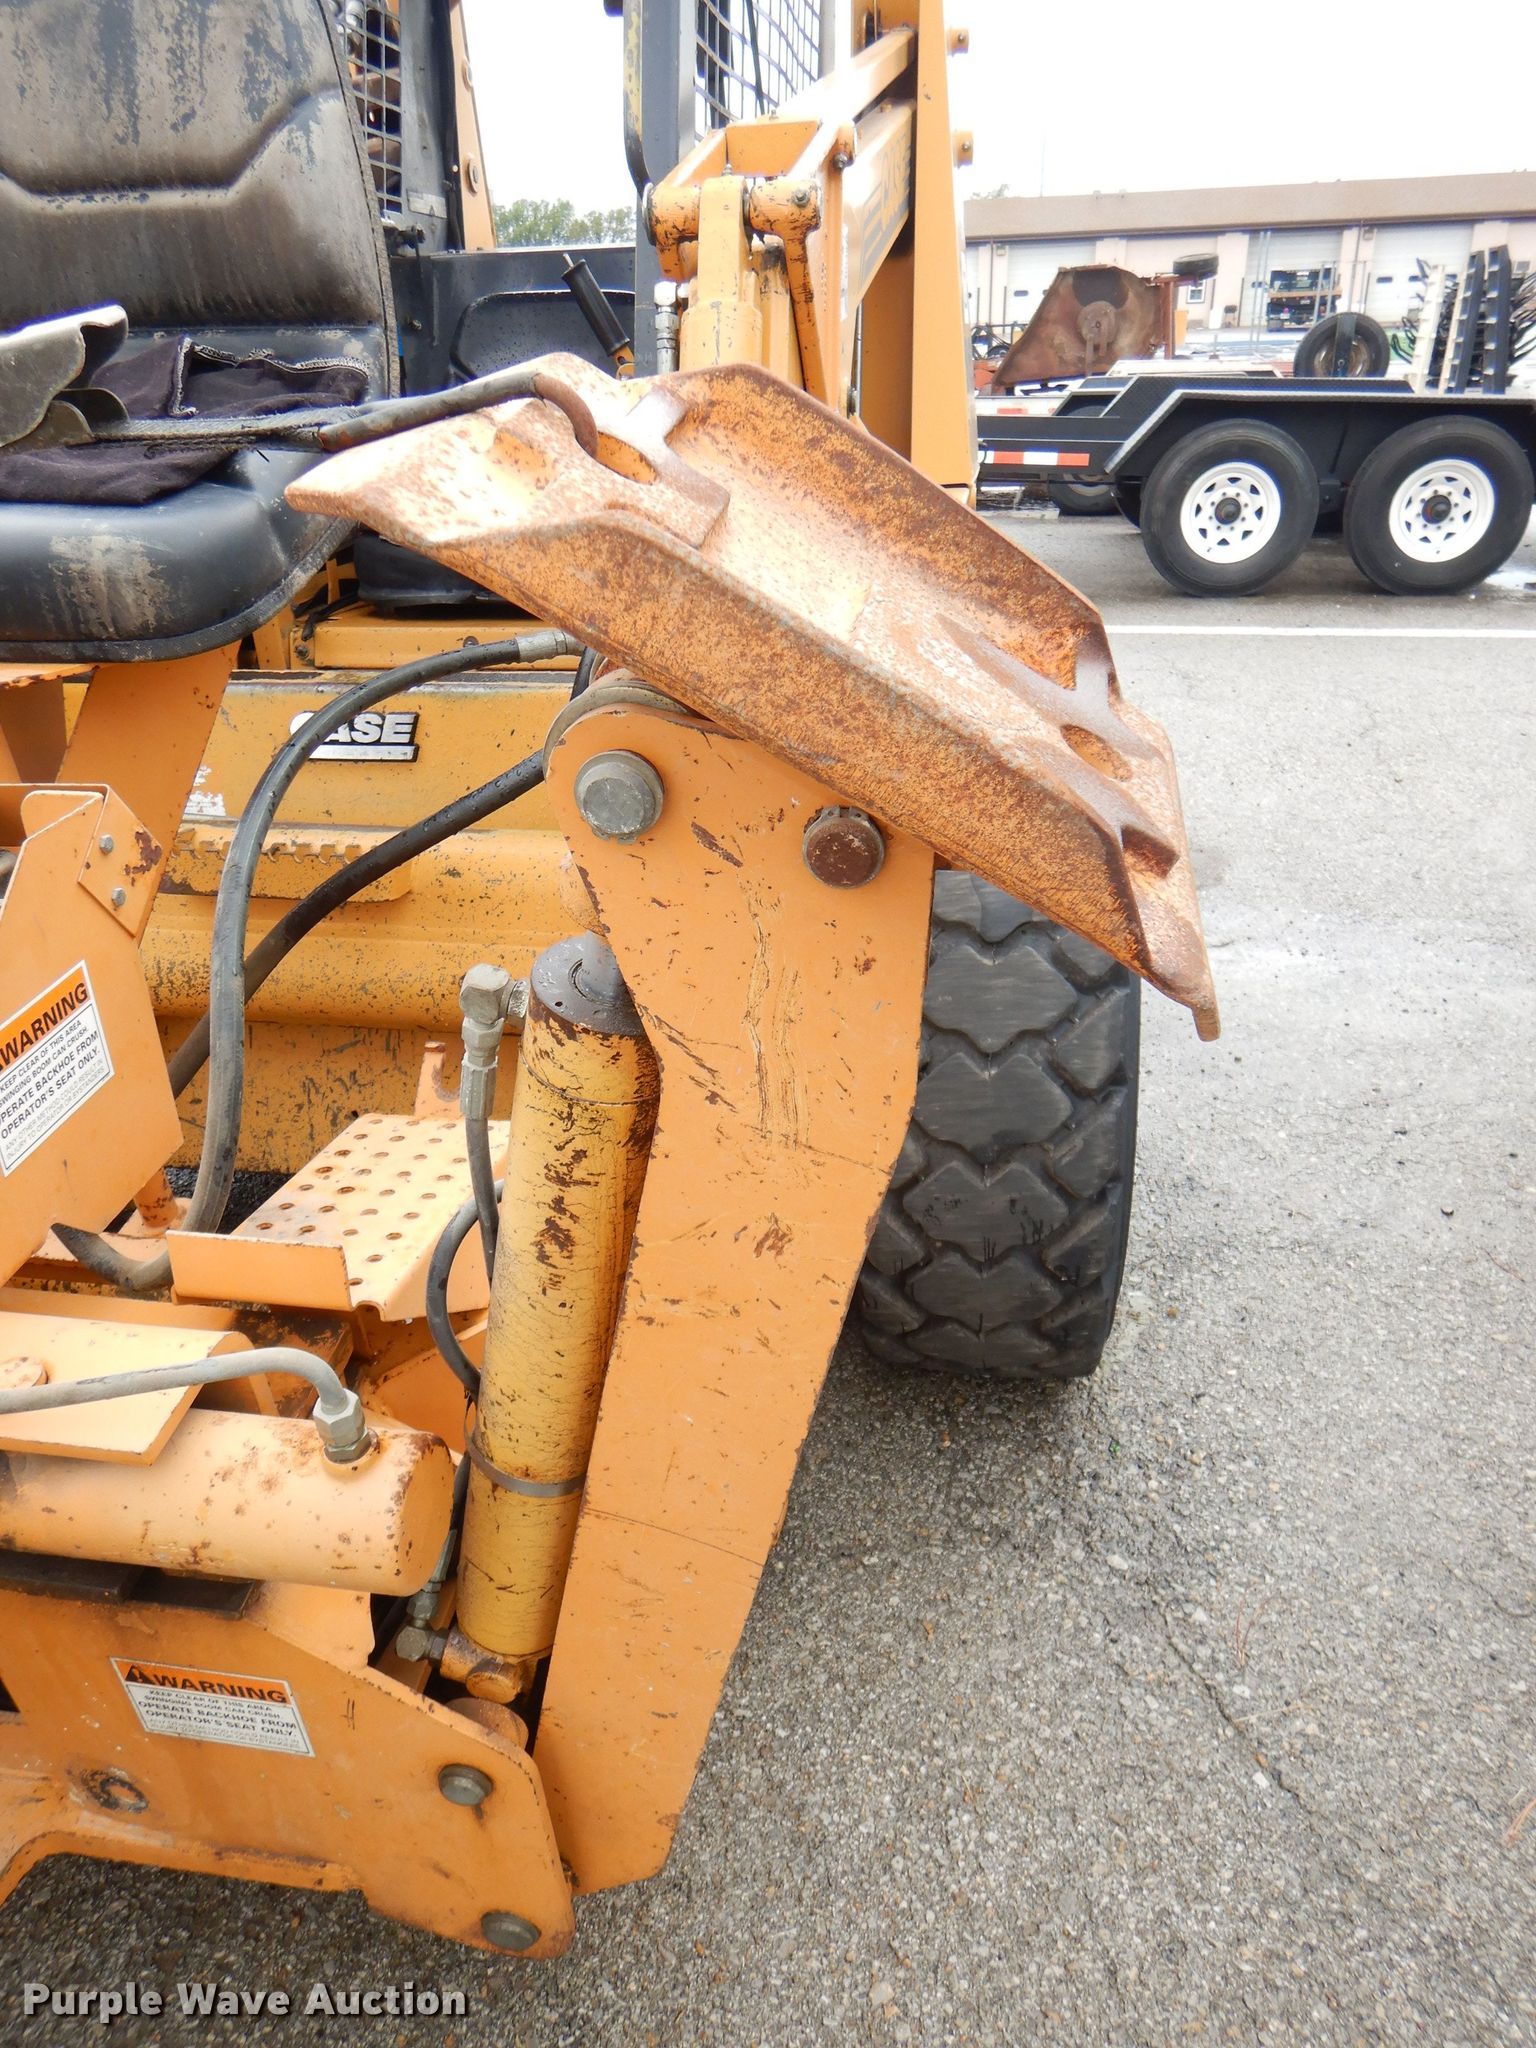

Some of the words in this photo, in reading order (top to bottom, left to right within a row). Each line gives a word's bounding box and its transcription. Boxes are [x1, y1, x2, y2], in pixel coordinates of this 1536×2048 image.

[0, 983, 88, 1066] WARNING
[0, 1074, 17, 1092] KEEP
[19, 1055, 40, 1077] CLEAR
[40, 1048, 49, 1060] OF
[49, 1034, 64, 1050] THIS
[65, 1020, 82, 1037] AREA
[0, 1088, 34, 1123] PERATE
[35, 1051, 75, 1092] BACKHOE
[76, 1030, 99, 1056] FROM
[32, 1057, 51, 1078] BOOM
[52, 1045, 66, 1060] CAN
[1, 1086, 54, 1139] OPERATOR'S
[55, 1065, 76, 1090] SEAT
[78, 1046, 100, 1070] ONLY.
[153, 1674, 287, 1703] WARNING
[138, 1701, 194, 1714] OPERATE
[197, 1709, 256, 1722] BACKHOE
[261, 1719, 297, 1729] FROM
[145, 1710, 222, 1726] OPERATOR'S
[225, 1720, 256, 1730] SEAT
